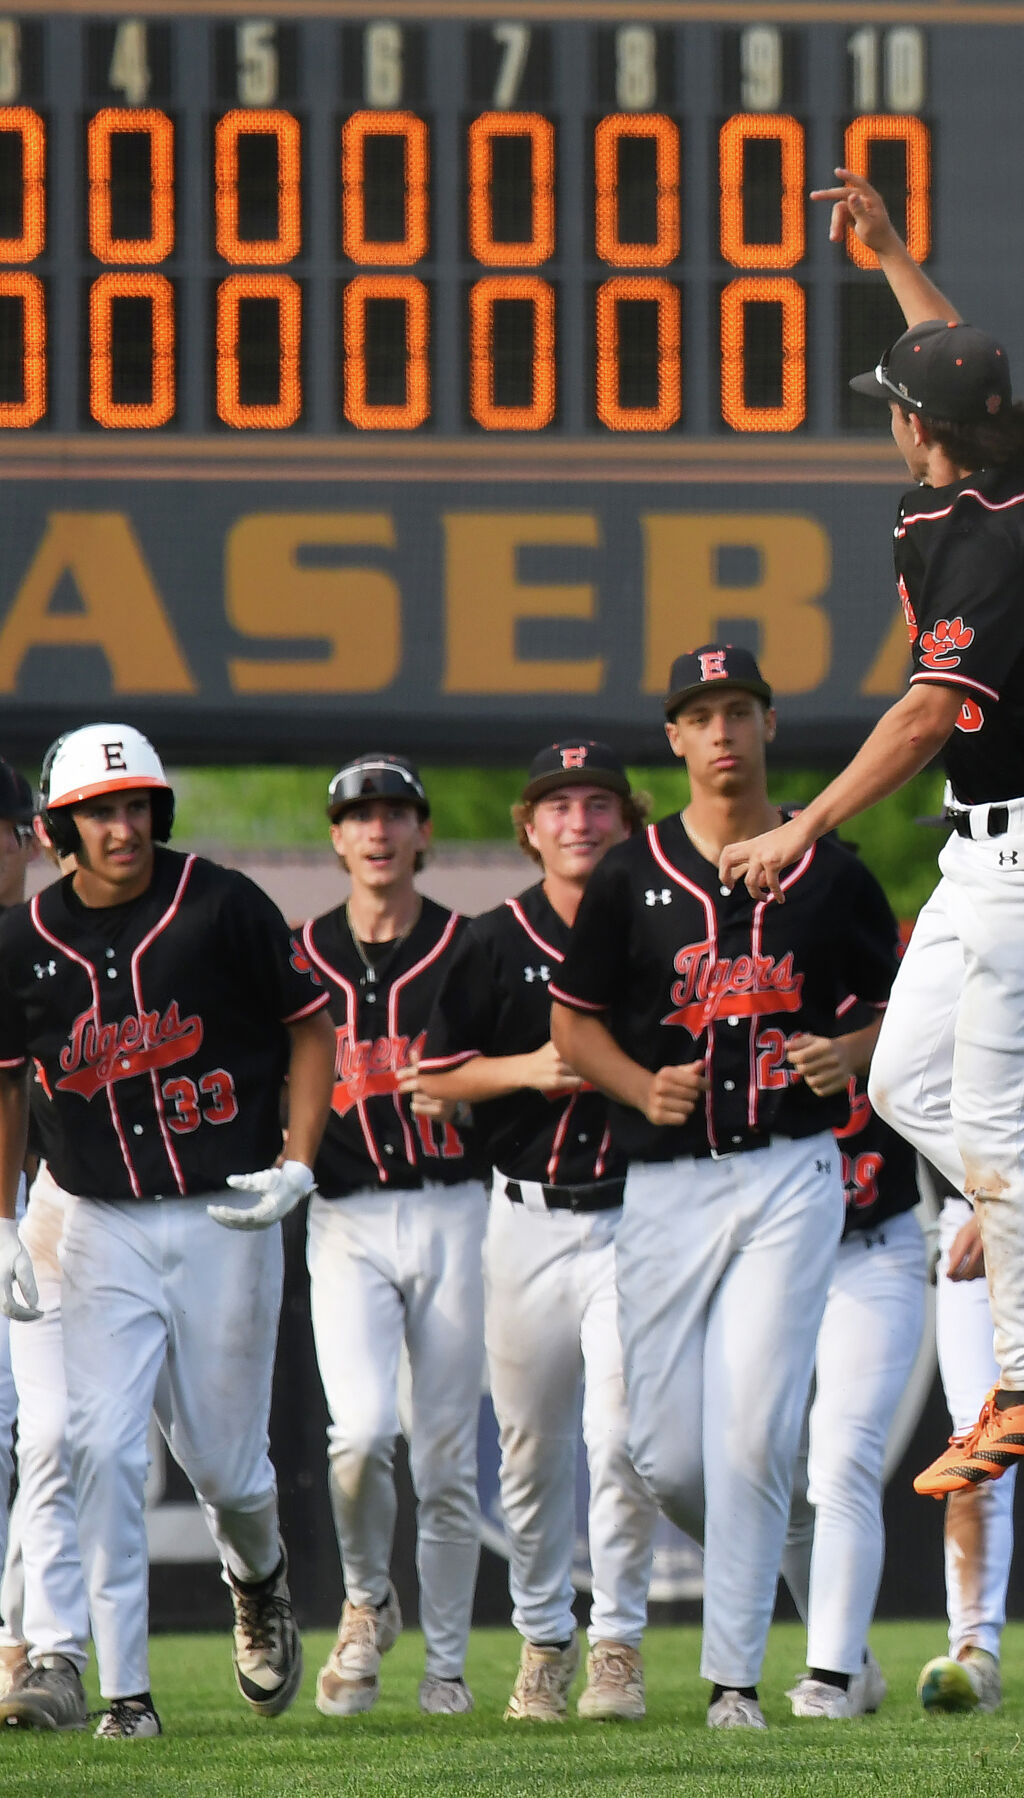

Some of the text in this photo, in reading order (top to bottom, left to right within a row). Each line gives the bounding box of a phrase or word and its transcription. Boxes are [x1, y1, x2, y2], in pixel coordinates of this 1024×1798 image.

[107, 23, 148, 102] 4
[238, 23, 277, 104] 5
[364, 25, 402, 106] 6
[494, 26, 531, 108] 7
[616, 27, 657, 109] 8
[741, 27, 782, 110] 9
[847, 27, 925, 111] 10
[88, 108, 175, 265] 0
[215, 109, 301, 265] 0
[342, 111, 428, 266] 0
[469, 112, 555, 267] 0
[595, 113, 680, 268] 0
[719, 114, 805, 269] 0
[844, 115, 931, 270] 0
[90, 272, 176, 428] 0
[217, 273, 302, 429] 0
[344, 274, 430, 430] 0
[470, 276, 556, 430] 0
[597, 277, 681, 431] 0
[721, 277, 806, 432] 0
[698, 650, 729, 682] E
[101, 741, 127, 771] E
[670, 940, 797, 1022] Tigers
[60, 1000, 182, 1083] Tigers
[756, 1027, 800, 1091] 2
[161, 1068, 239, 1134] 33
